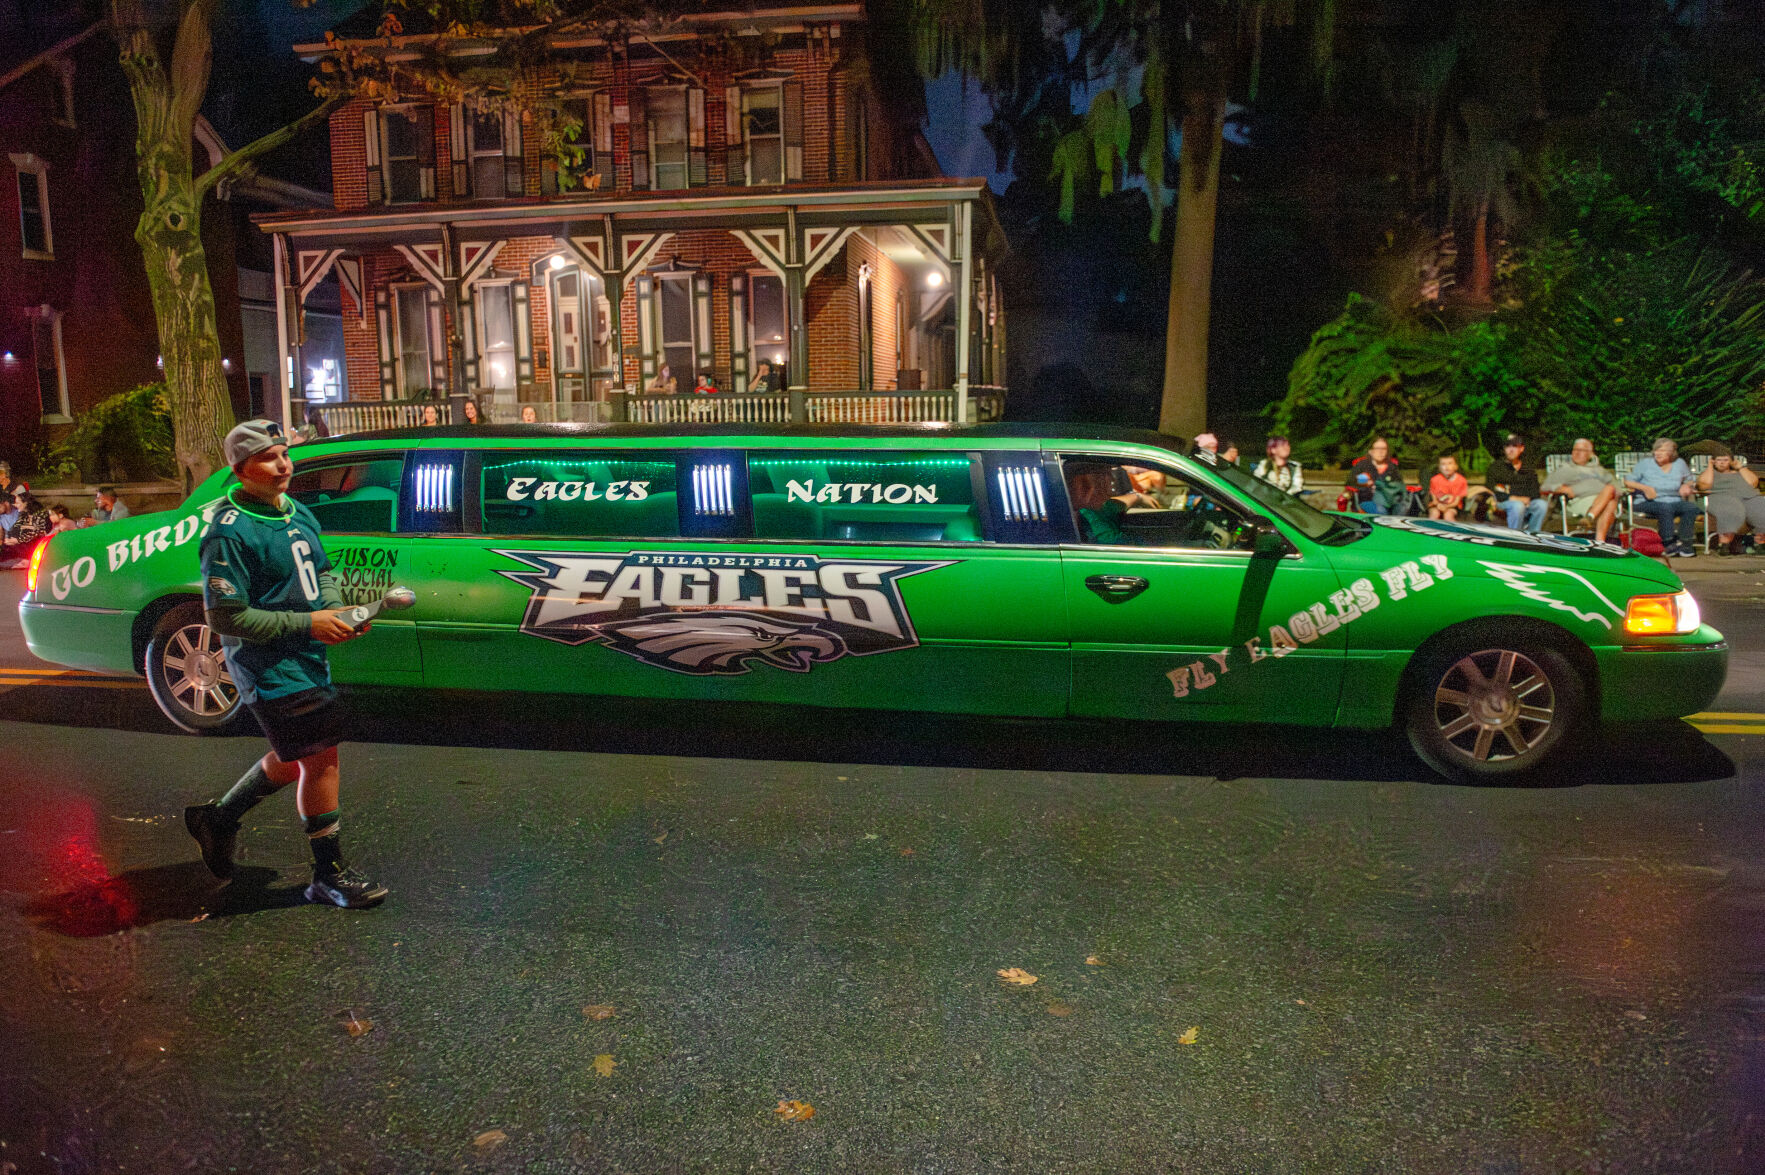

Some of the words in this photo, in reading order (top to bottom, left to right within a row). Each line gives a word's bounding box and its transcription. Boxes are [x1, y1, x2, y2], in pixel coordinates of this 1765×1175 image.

[785, 479, 938, 504] NATION
[220, 509, 239, 525] 6
[291, 540, 320, 601] 6
[637, 555, 808, 568] PHILADELPHIA
[51, 556, 97, 600] GO
[340, 567, 396, 588] SOCIAL
[340, 588, 383, 607] MEDI
[534, 556, 908, 639] EAGLES
[1165, 647, 1231, 698] FLY
[1243, 577, 1381, 664] EAGLES
[1379, 553, 1454, 601] FLY
